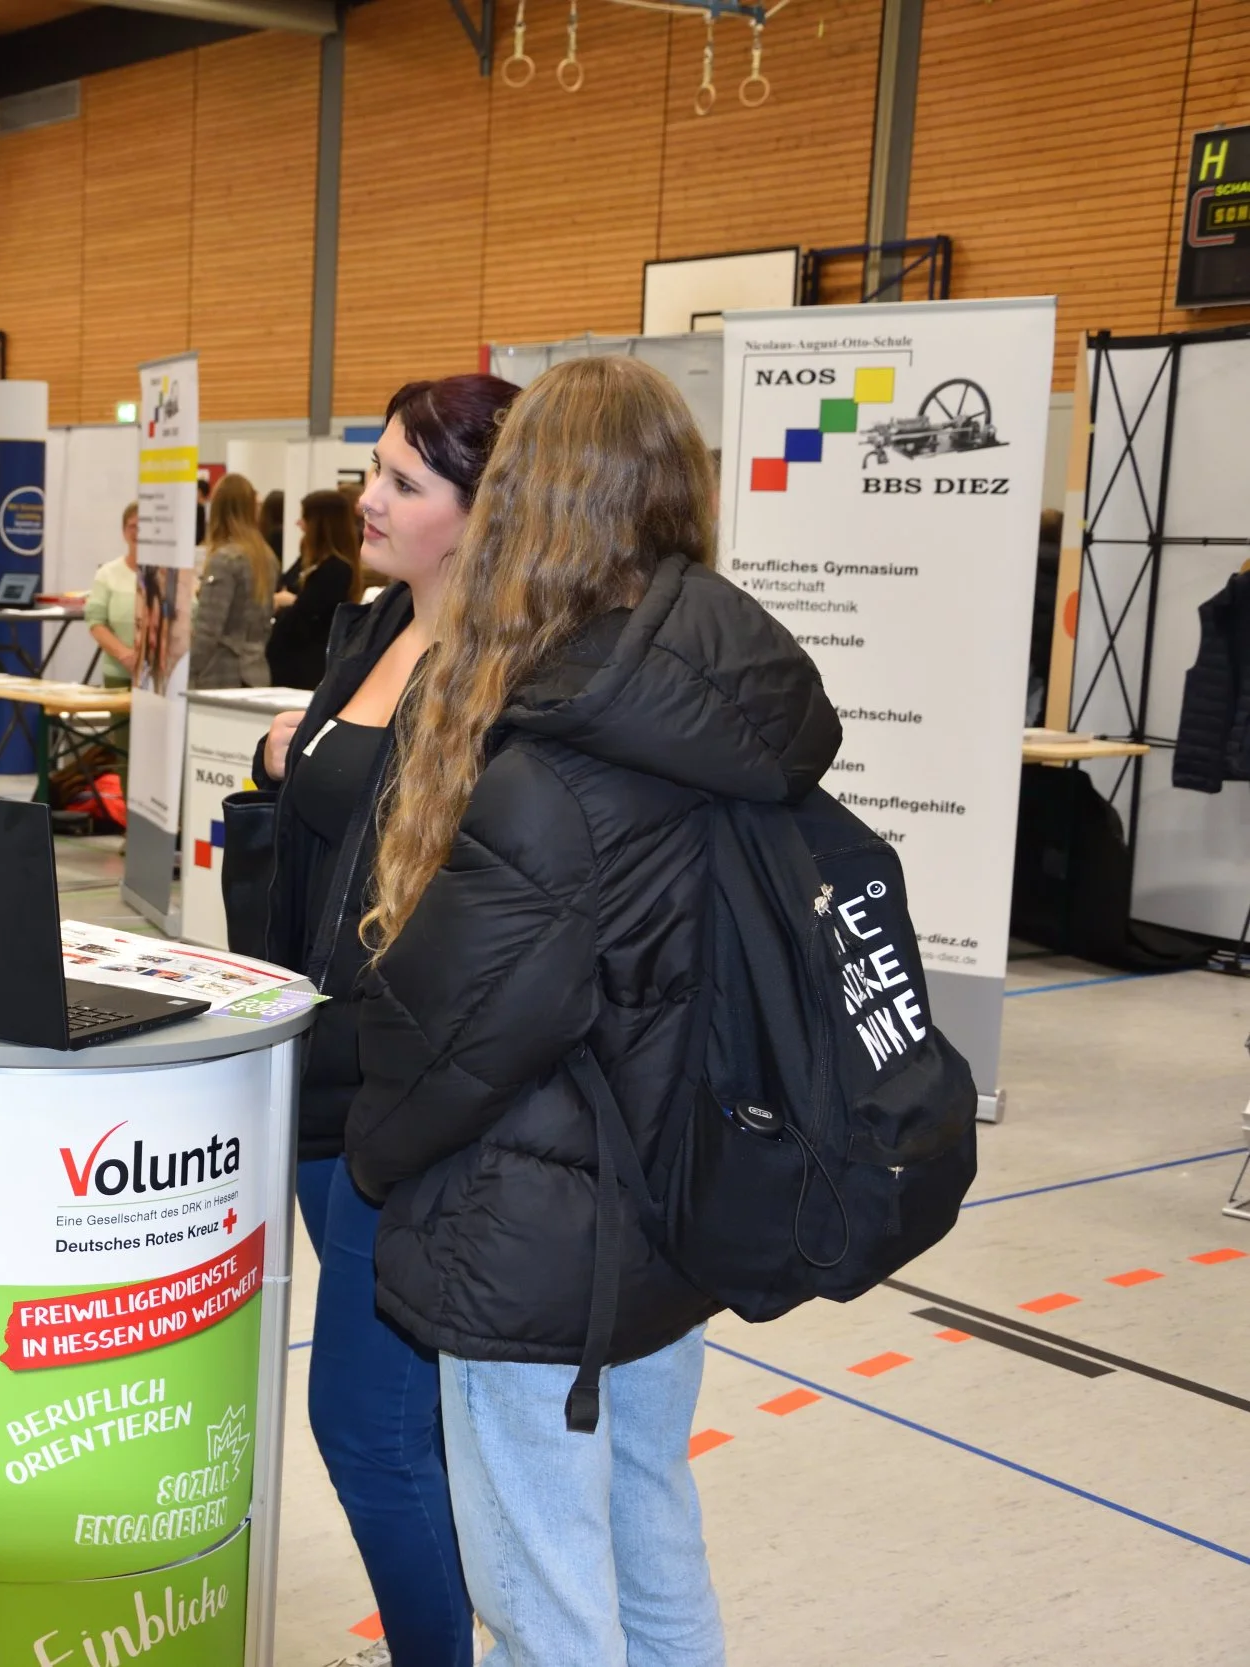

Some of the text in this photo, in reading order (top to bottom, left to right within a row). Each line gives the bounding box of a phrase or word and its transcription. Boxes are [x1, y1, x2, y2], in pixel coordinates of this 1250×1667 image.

[1199, 139, 1229, 182] H
[745, 336, 913, 351] Nicolaus-August-Otto-Schule
[755, 368, 836, 385] NAOS
[862, 478, 1010, 495] BBS DIEZ
[732, 558, 919, 577] Berufliches Gymnasium
[751, 578, 825, 593] Wirtschaft
[758, 598, 859, 614] mwelttechnik
[794, 633, 865, 648] erschule
[196, 768, 235, 789] NAOS
[831, 759, 866, 773] ulen
[837, 792, 966, 816] Altenpflegehilfe
[916, 932, 979, 949] s-diez.de
[856, 988, 927, 1072] NIKE
[59, 1120, 240, 1197] Volunta
[56, 1190, 239, 1227] Eine Gesellschaft des DRK in Hessen
[56, 1221, 219, 1253] Deutsches Rotes Kreuz
[20, 1255, 238, 1327] FREIWILLIGENDIENSTE
[22, 1267, 258, 1358] IN HESSEN UND WELTWEIT
[6, 1378, 165, 1446] BERUFLICH
[5, 1401, 193, 1485] ORIENTIEREN
[157, 1462, 231, 1506] SOZIAL
[75, 1496, 228, 1546] ENGAGIEREN
[33, 1577, 229, 1667] Einblicke
